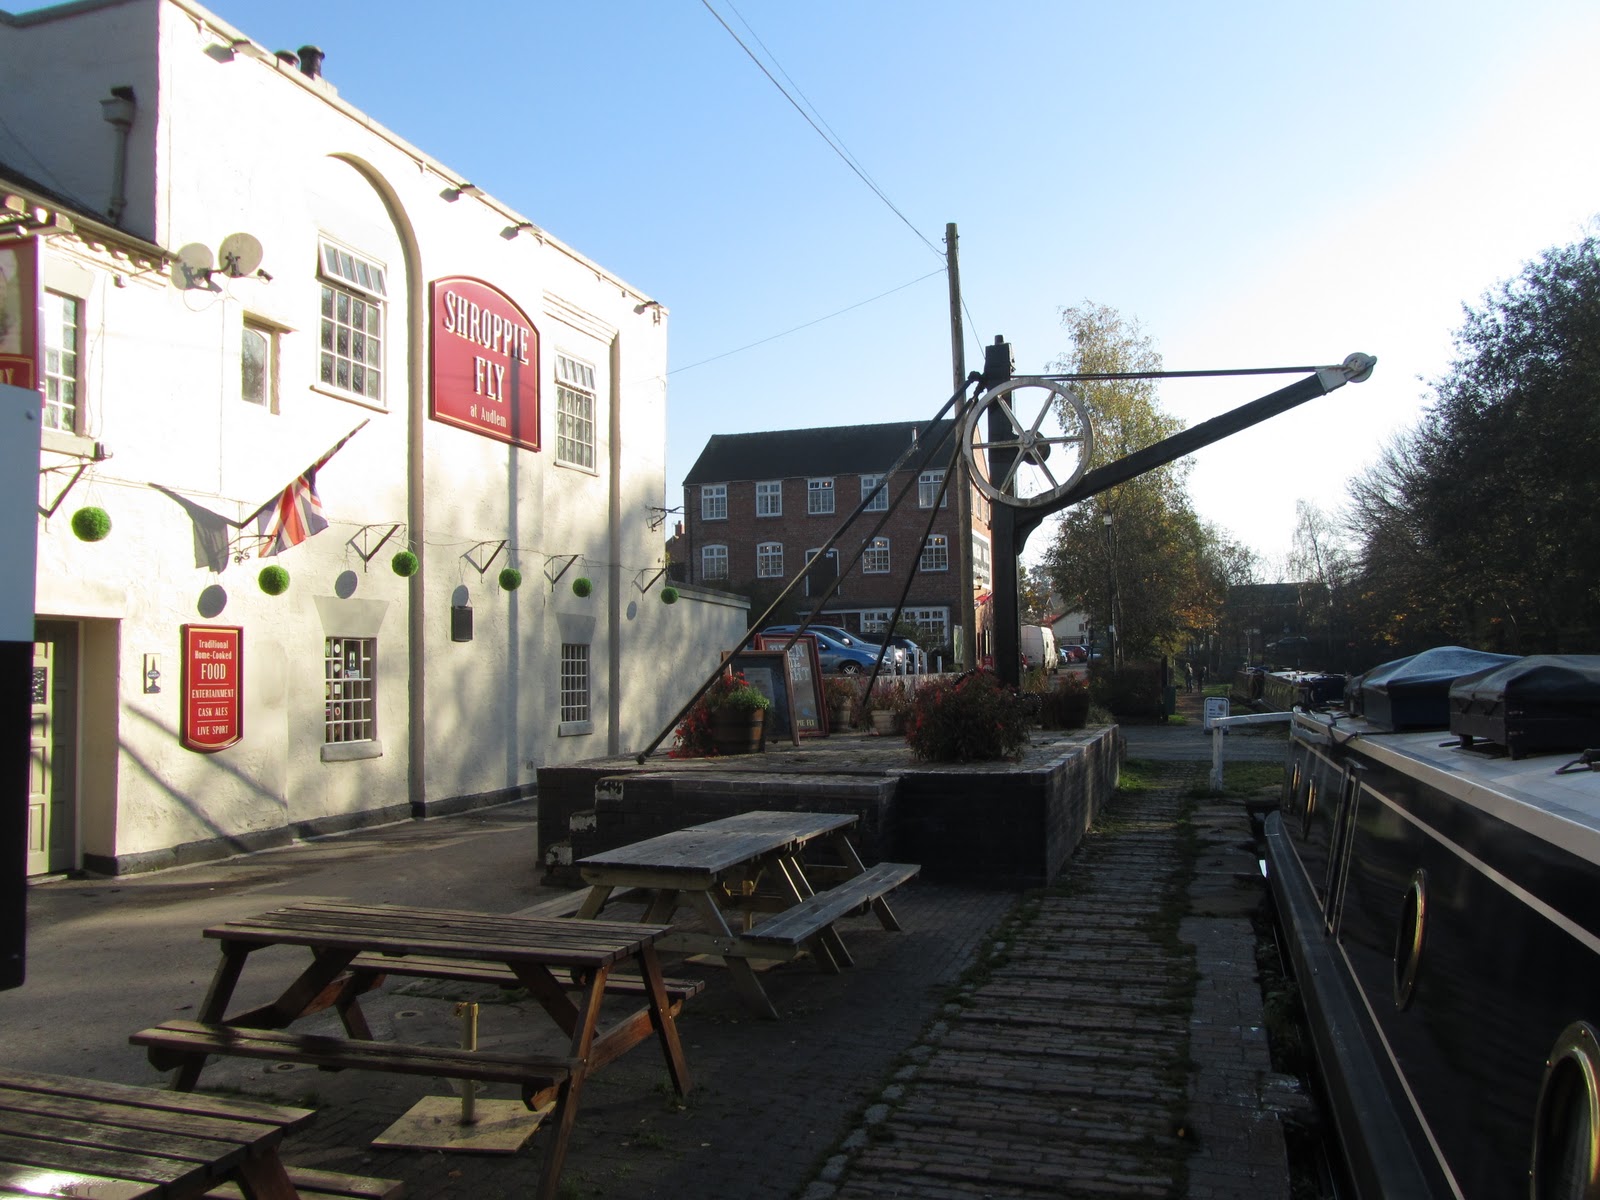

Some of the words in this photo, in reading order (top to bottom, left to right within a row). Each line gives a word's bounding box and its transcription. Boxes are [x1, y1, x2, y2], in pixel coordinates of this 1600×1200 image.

[444, 290, 529, 366] SHROPPIE
[475, 356, 505, 402] FLY
[470, 404, 478, 418] at
[481, 406, 507, 428] Audlem
[199, 639, 229, 649] Traditional
[194, 650, 232, 660] Home-Cooked
[201, 663, 226, 680] FOOD
[191, 688, 234, 699] ENTERTAINMENT
[198, 707, 212, 717] CASK
[214, 706, 229, 716] ALES
[197, 726, 210, 736] LIVE
[212, 725, 229, 735] SPORT
